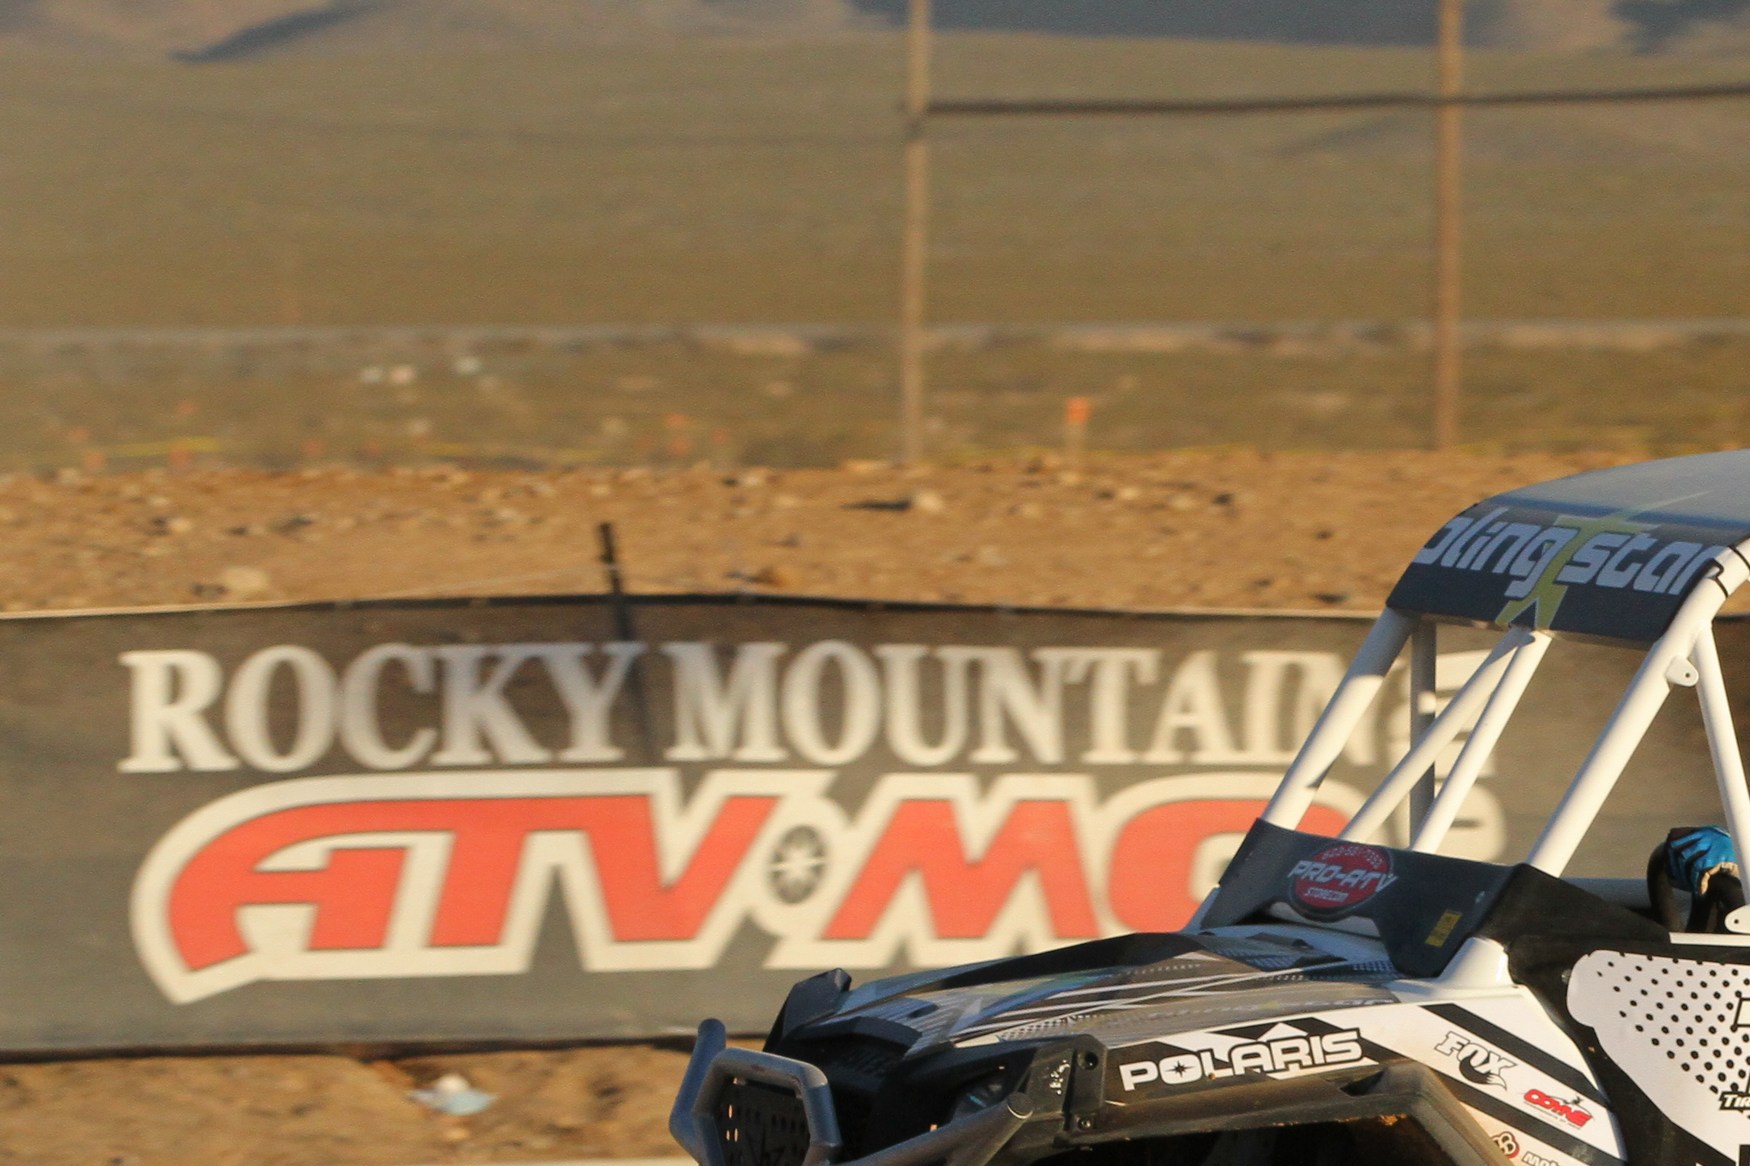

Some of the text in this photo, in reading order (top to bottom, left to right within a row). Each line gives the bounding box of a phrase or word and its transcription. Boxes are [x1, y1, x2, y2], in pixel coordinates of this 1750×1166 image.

[1557, 530, 1727, 595] star
[118, 642, 647, 772] ROCKY
[661, 641, 1392, 766] MOUNTAIN
[1287, 860, 1399, 893] PRO-ATV
[1119, 1028, 1362, 1092] POLARIS
[1434, 1030, 1518, 1086] FOX
